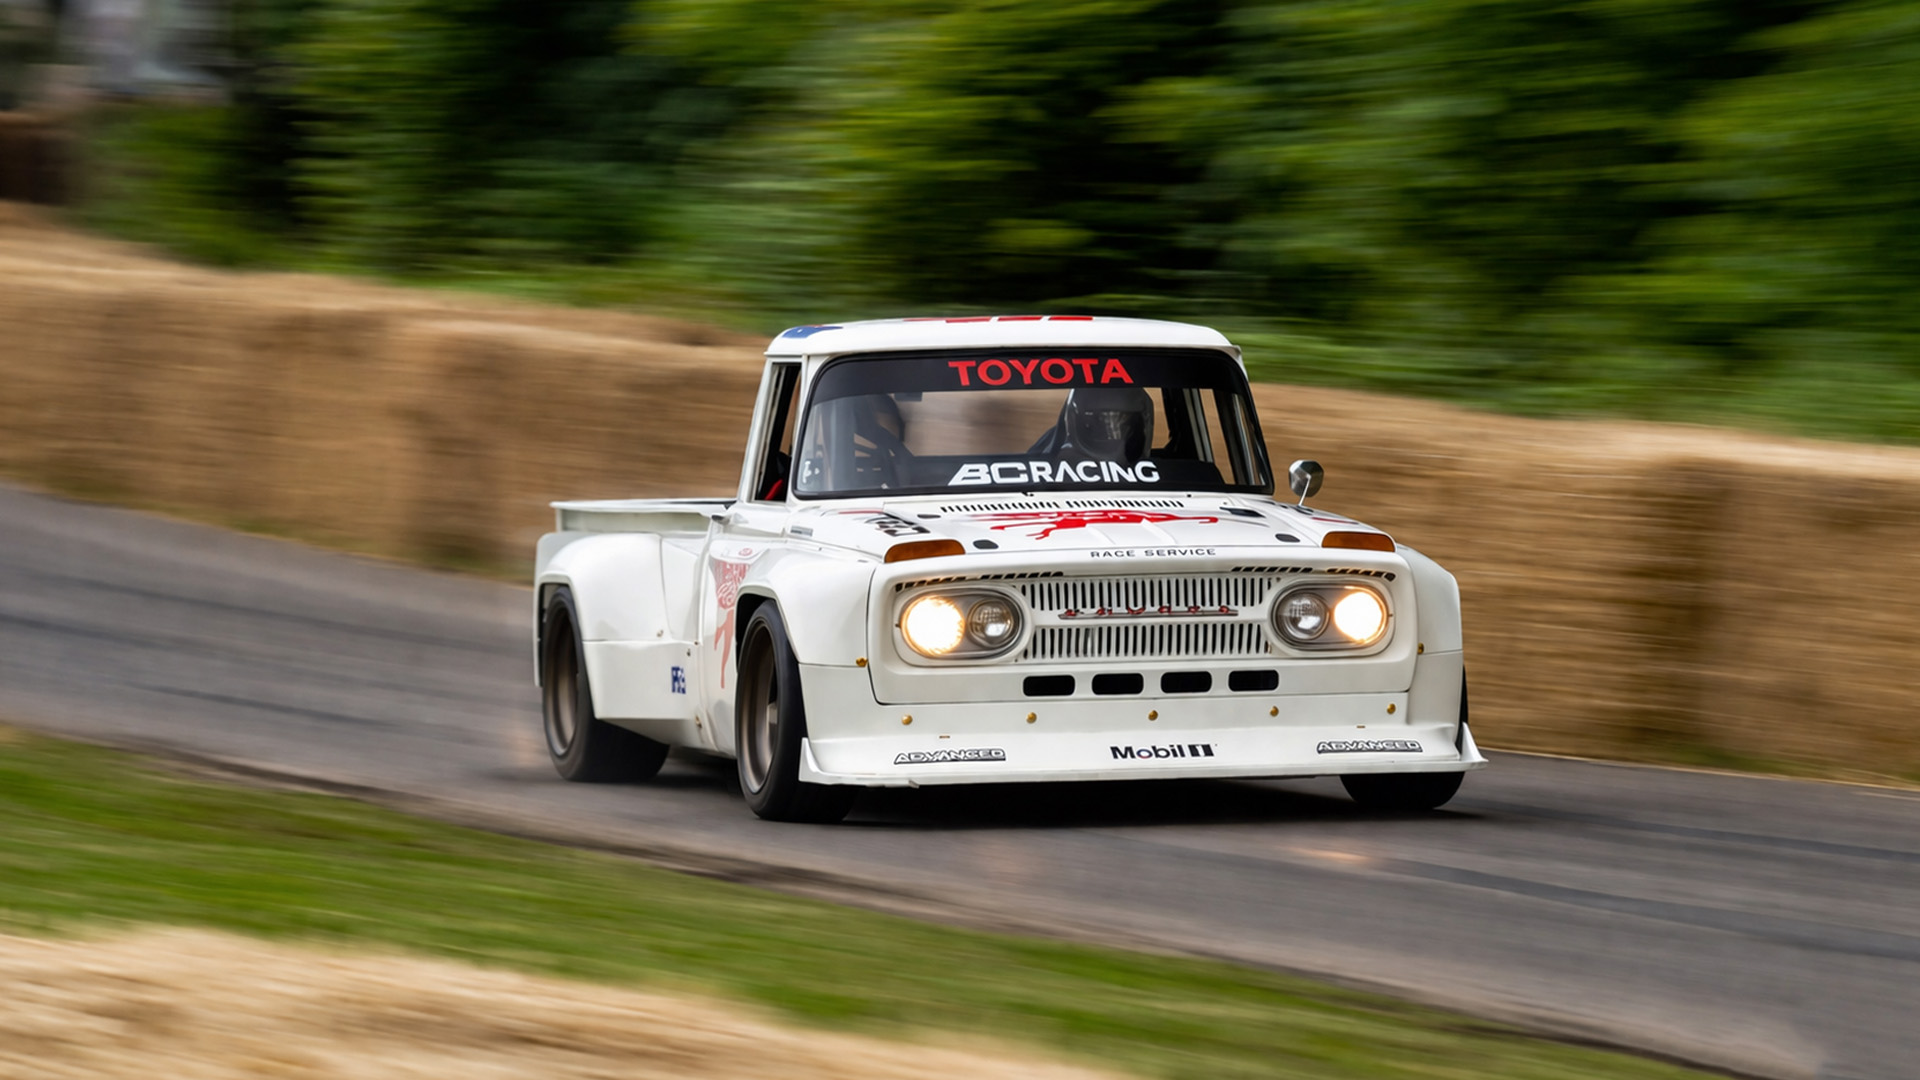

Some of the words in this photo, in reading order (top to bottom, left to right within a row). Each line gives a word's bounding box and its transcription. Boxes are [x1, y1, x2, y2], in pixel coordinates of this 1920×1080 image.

[948, 358, 1134, 386] TOYOTA
[1090, 549, 1136, 558] RACE
[1144, 547, 1217, 557] SERVICE
[1110, 744, 1187, 760] Mobil
